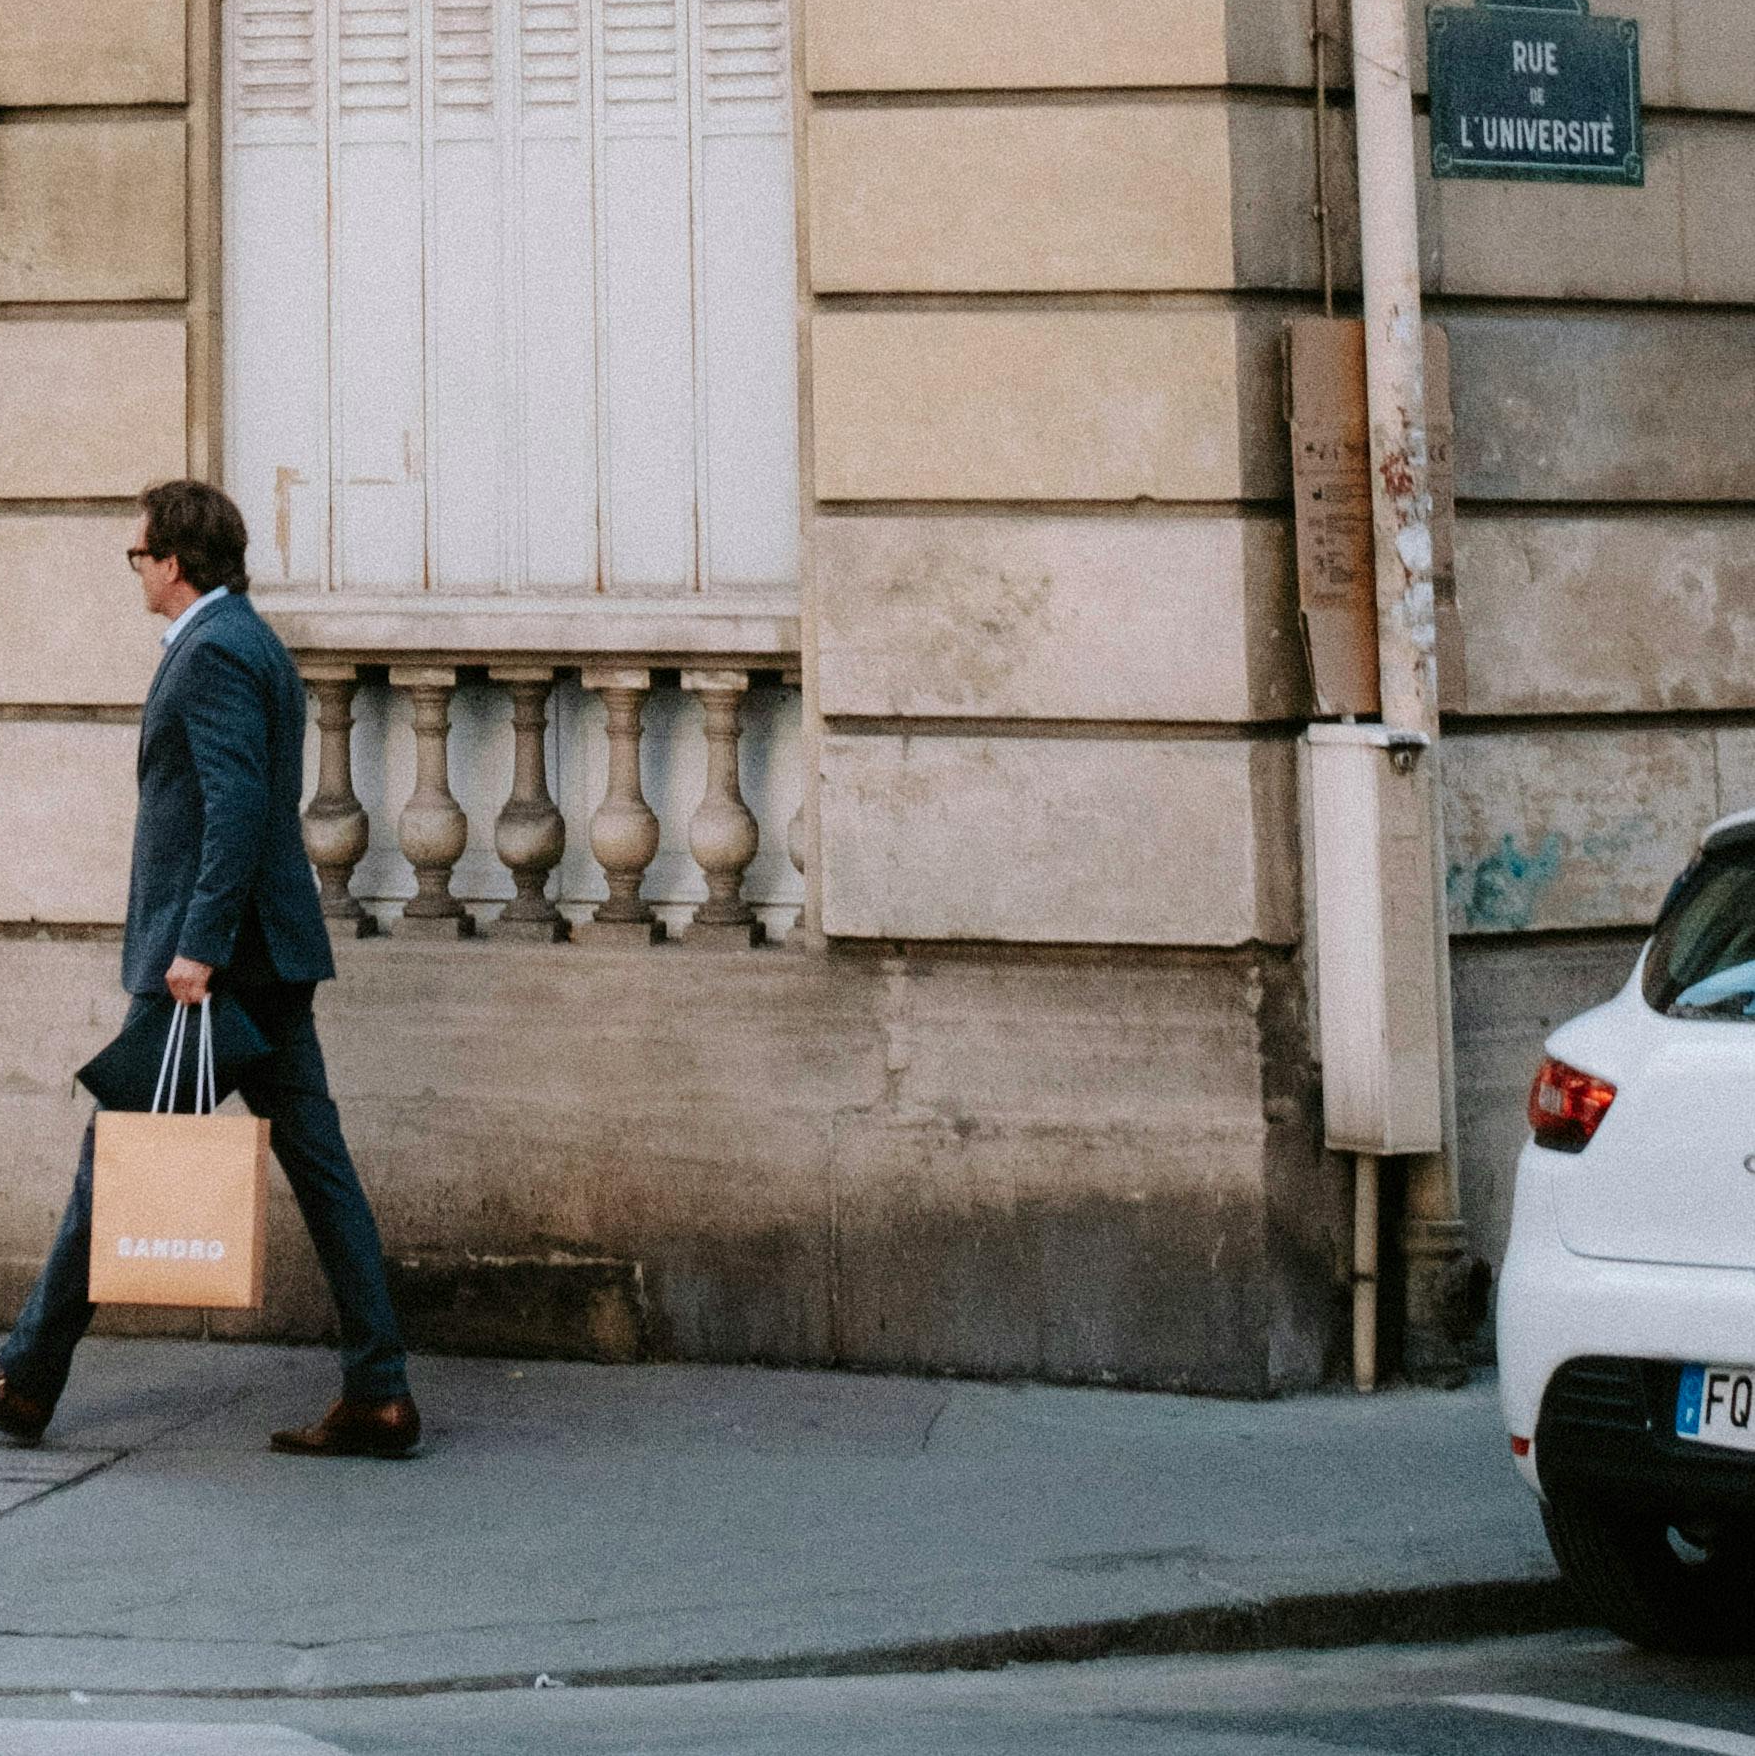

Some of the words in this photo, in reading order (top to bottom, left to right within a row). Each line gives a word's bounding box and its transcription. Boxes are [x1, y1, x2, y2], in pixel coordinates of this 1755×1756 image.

[1511, 40, 1559, 76] RUE
[1529, 87, 1545, 106] DE
[1460, 113, 1615, 155] L'UNIVERSITÉ
